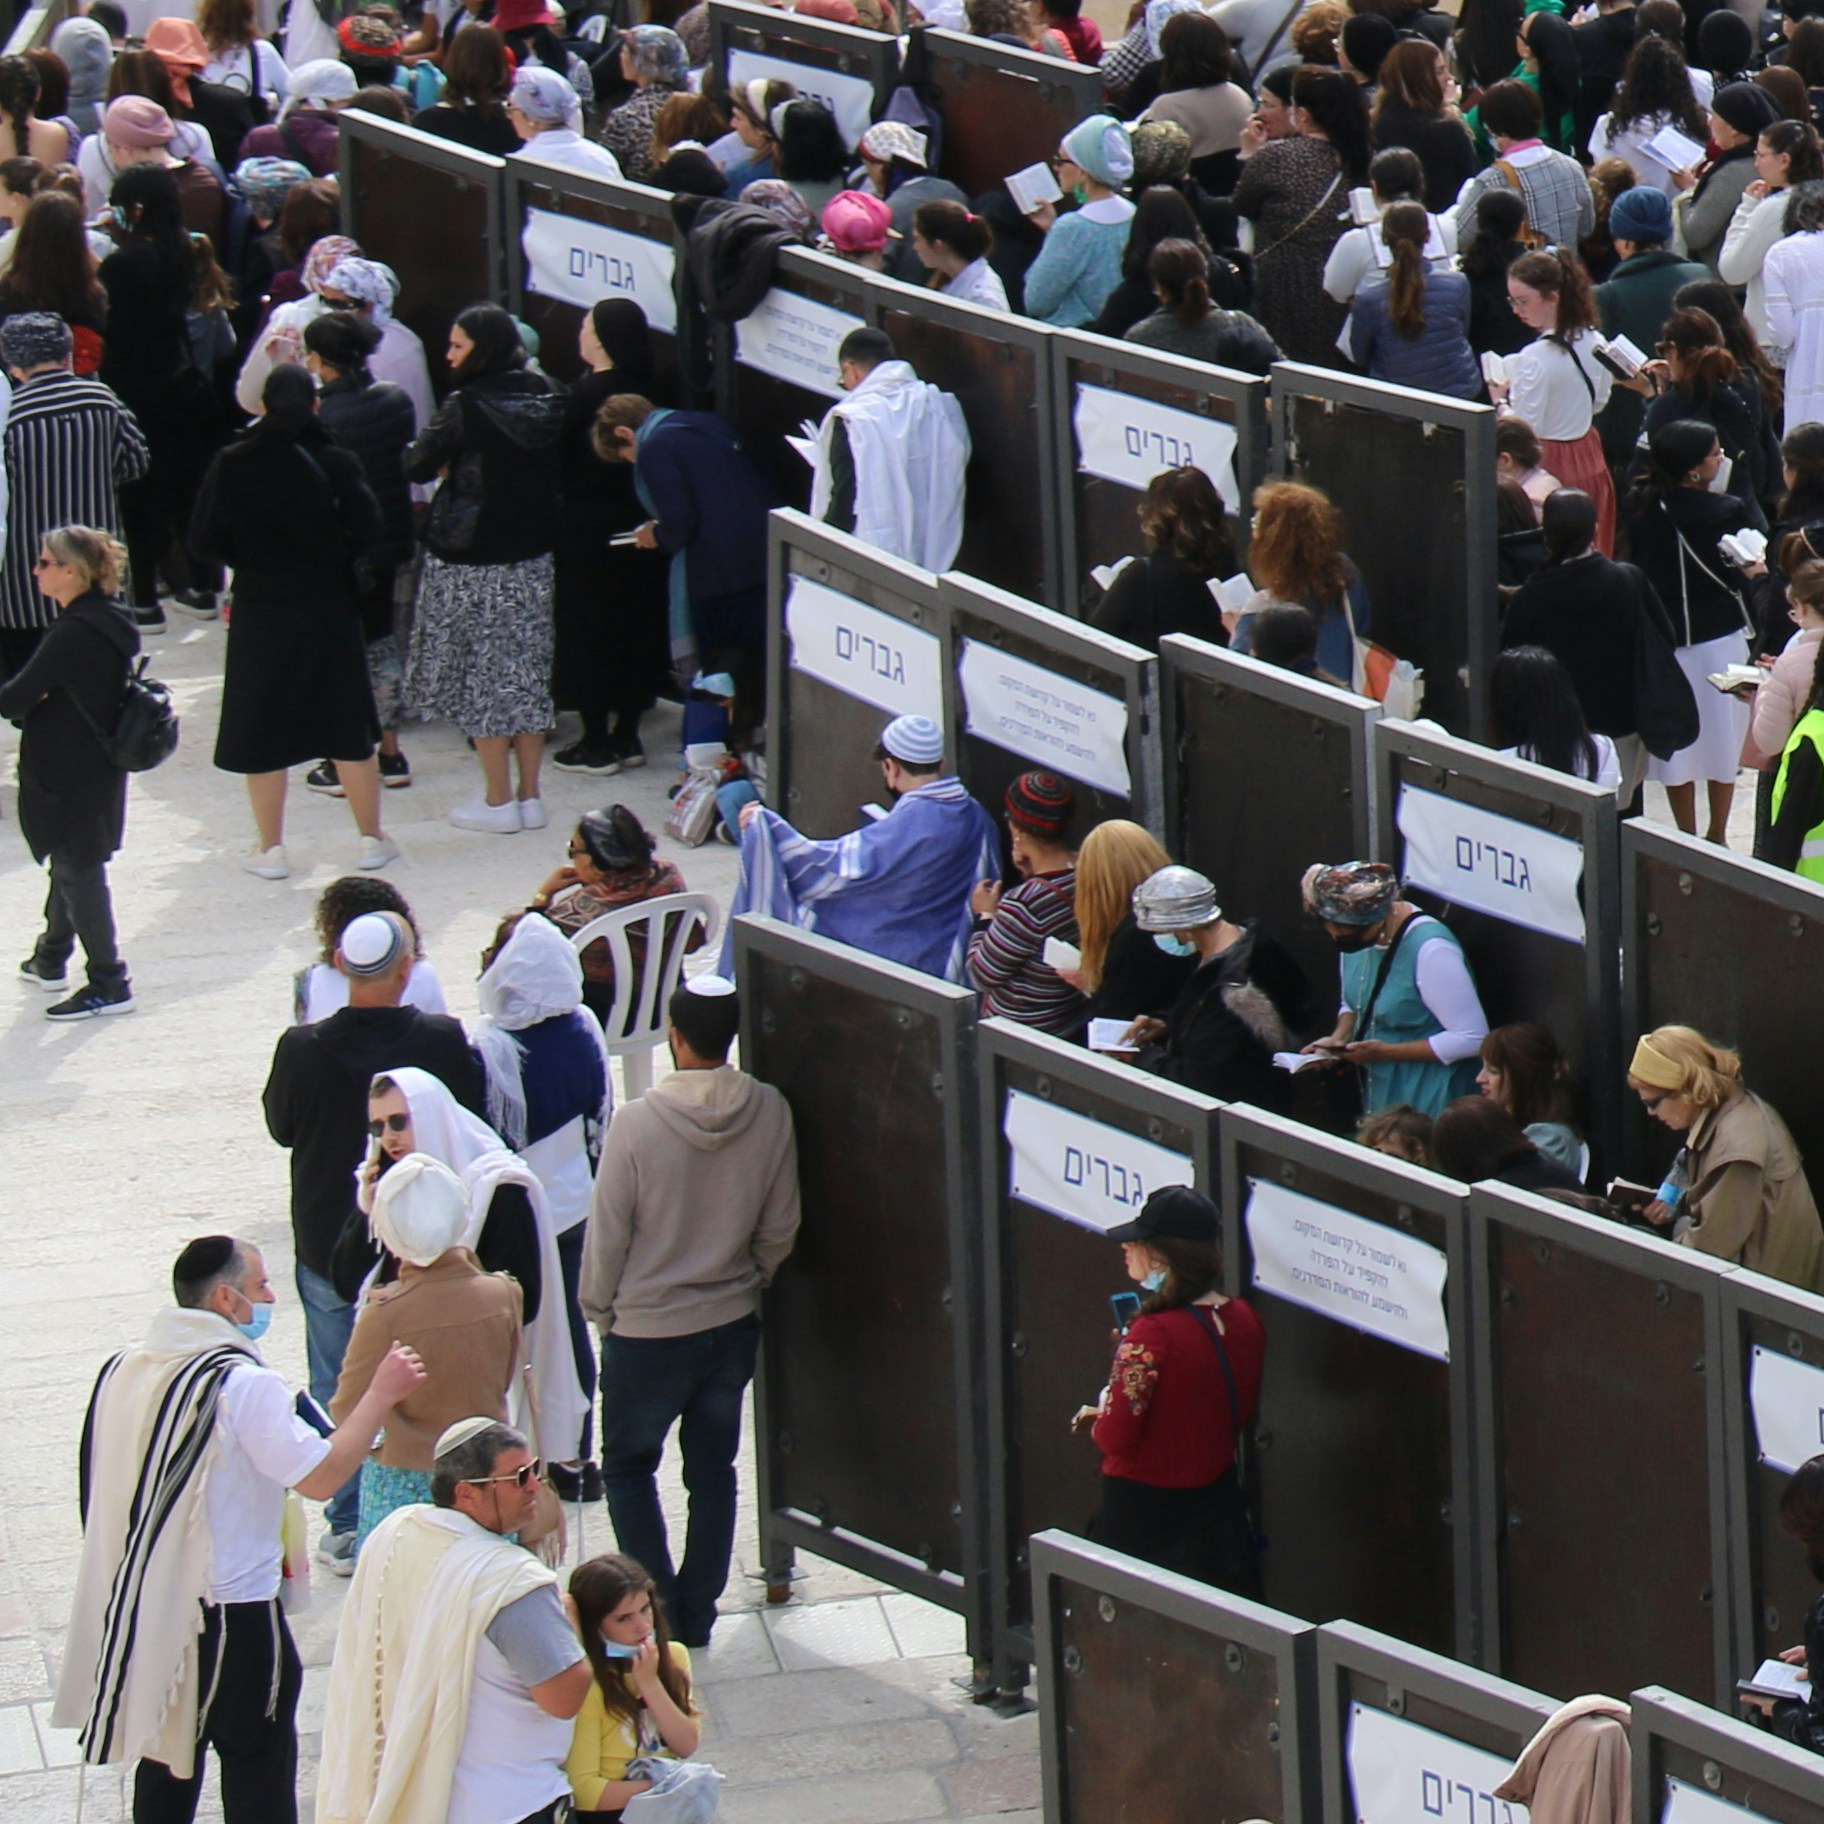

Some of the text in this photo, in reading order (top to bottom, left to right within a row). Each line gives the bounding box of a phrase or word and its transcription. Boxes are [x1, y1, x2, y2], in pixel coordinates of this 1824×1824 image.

[569, 247, 636, 292] גברים
[1124, 425, 1194, 468] גברים
[836, 625, 906, 685] גברים
[1455, 835, 1532, 893] גברים
[1063, 1146, 1145, 1207] גברים
